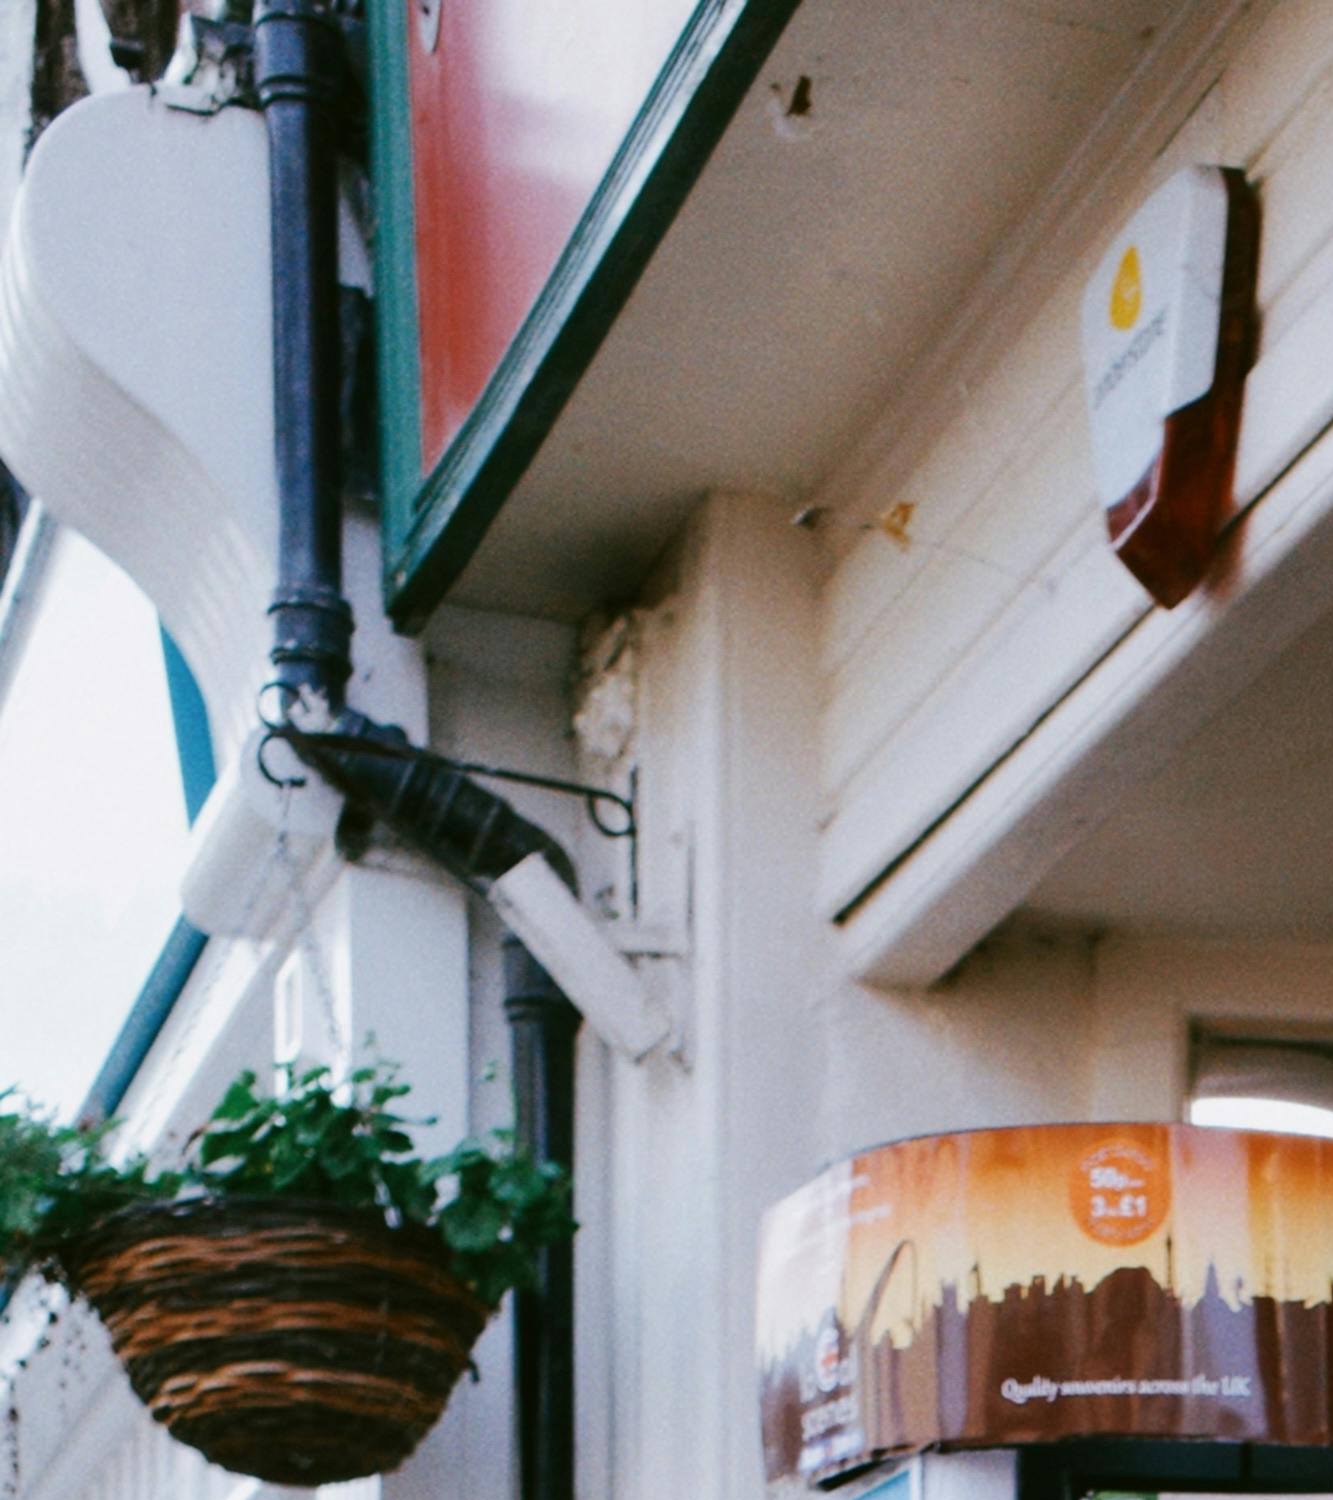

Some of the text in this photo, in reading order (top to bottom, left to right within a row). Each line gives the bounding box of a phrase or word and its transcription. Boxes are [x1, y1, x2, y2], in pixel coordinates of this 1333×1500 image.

[1001, 1374, 1252, 1405] Quality souvenirs across the UK
